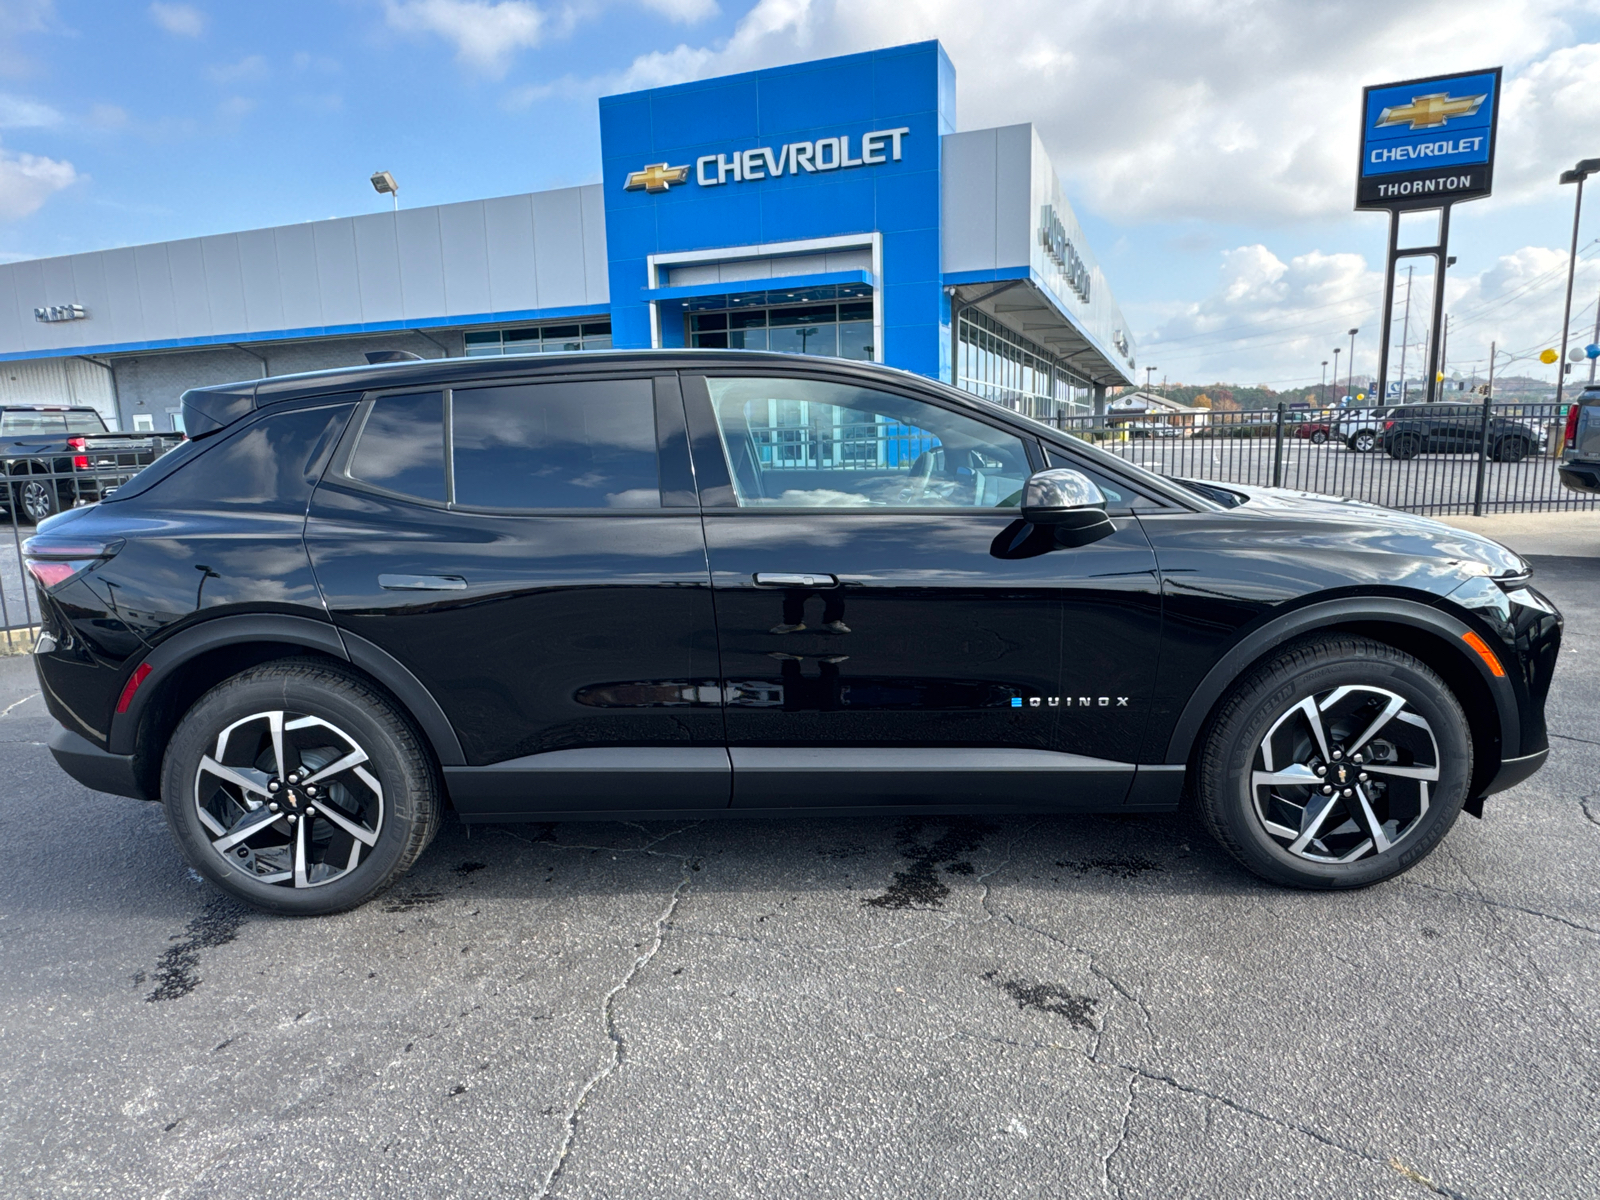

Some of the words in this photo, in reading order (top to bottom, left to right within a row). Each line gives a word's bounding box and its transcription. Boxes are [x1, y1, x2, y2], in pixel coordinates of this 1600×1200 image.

[696, 127, 910, 186] CHEVROLET
[1370, 137, 1484, 164] CHEVROLET
[1378, 175, 1471, 197] THORNTON
[34, 304, 85, 322] PARTS
[1010, 696, 1129, 708] EQUINOX
[1240, 684, 1293, 746] MICHELIN
